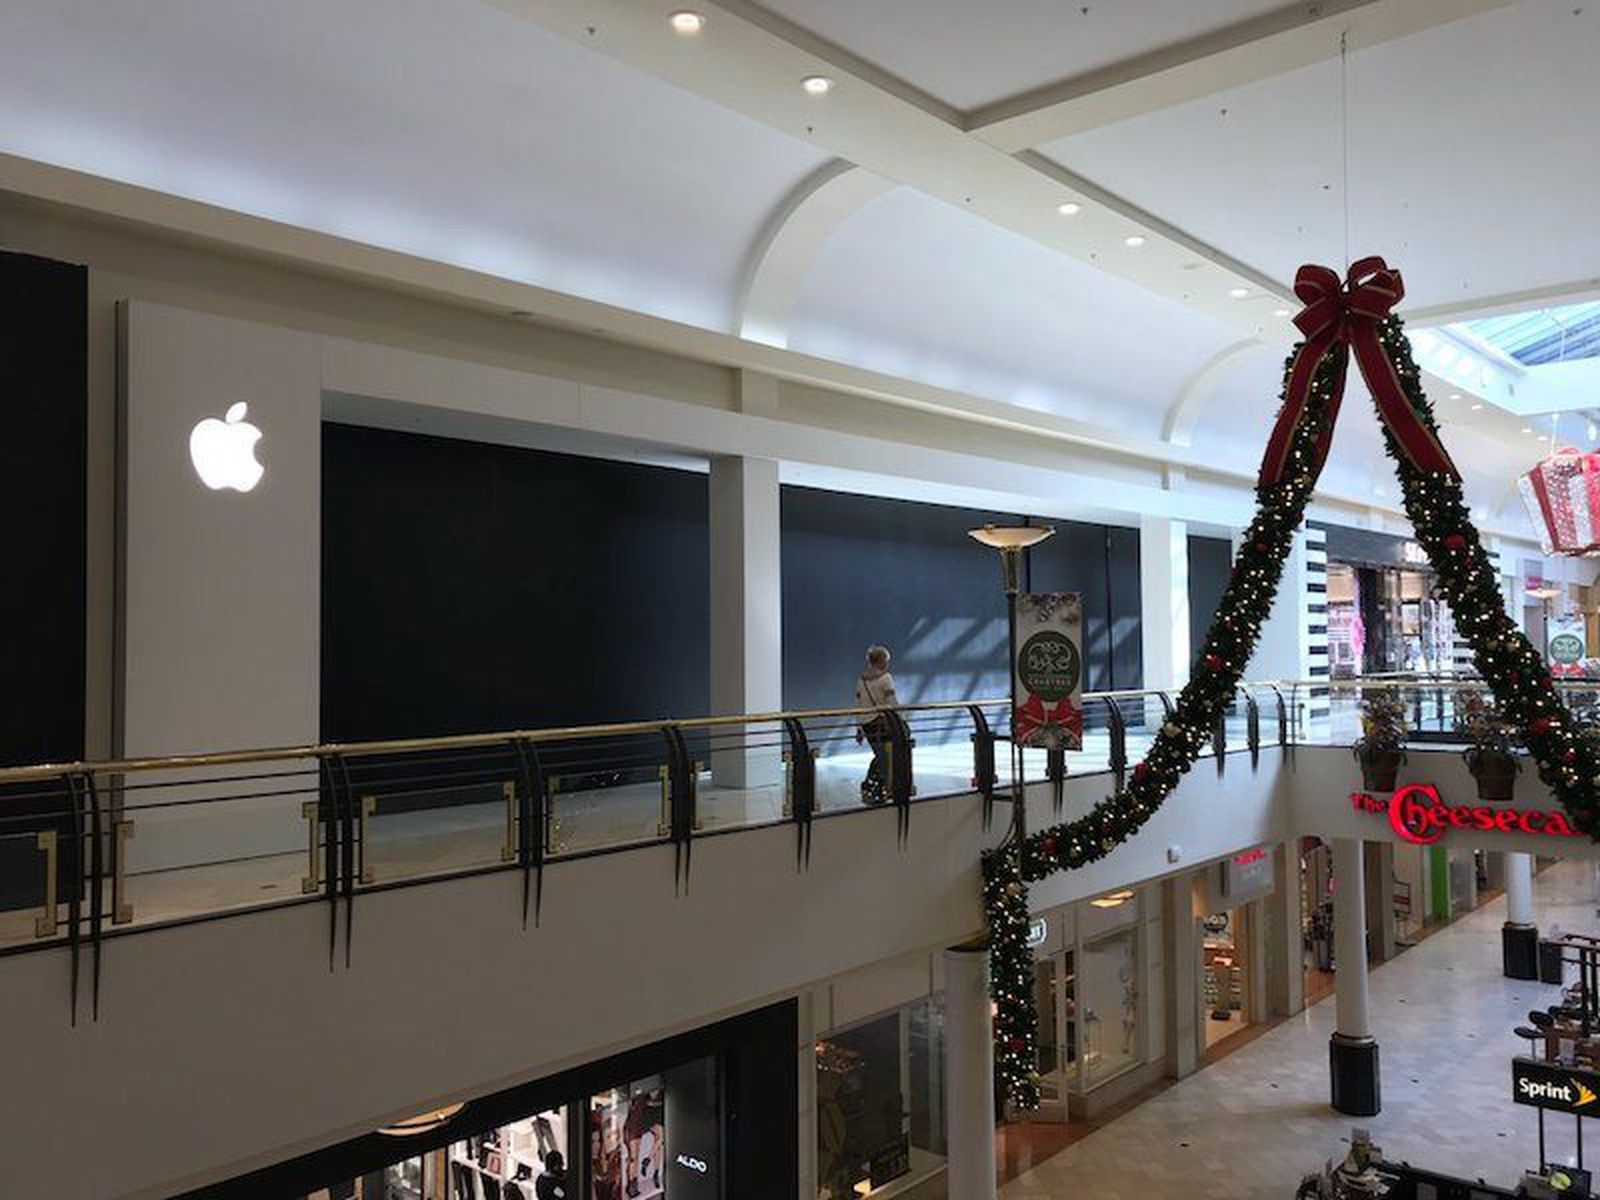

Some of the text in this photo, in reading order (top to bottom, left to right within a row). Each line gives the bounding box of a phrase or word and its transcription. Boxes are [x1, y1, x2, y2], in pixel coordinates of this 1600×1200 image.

[1349, 783, 1586, 844] The Cheeseca
[1519, 1077, 1572, 1102] Sprint
[676, 1154, 707, 1173] ALDO
